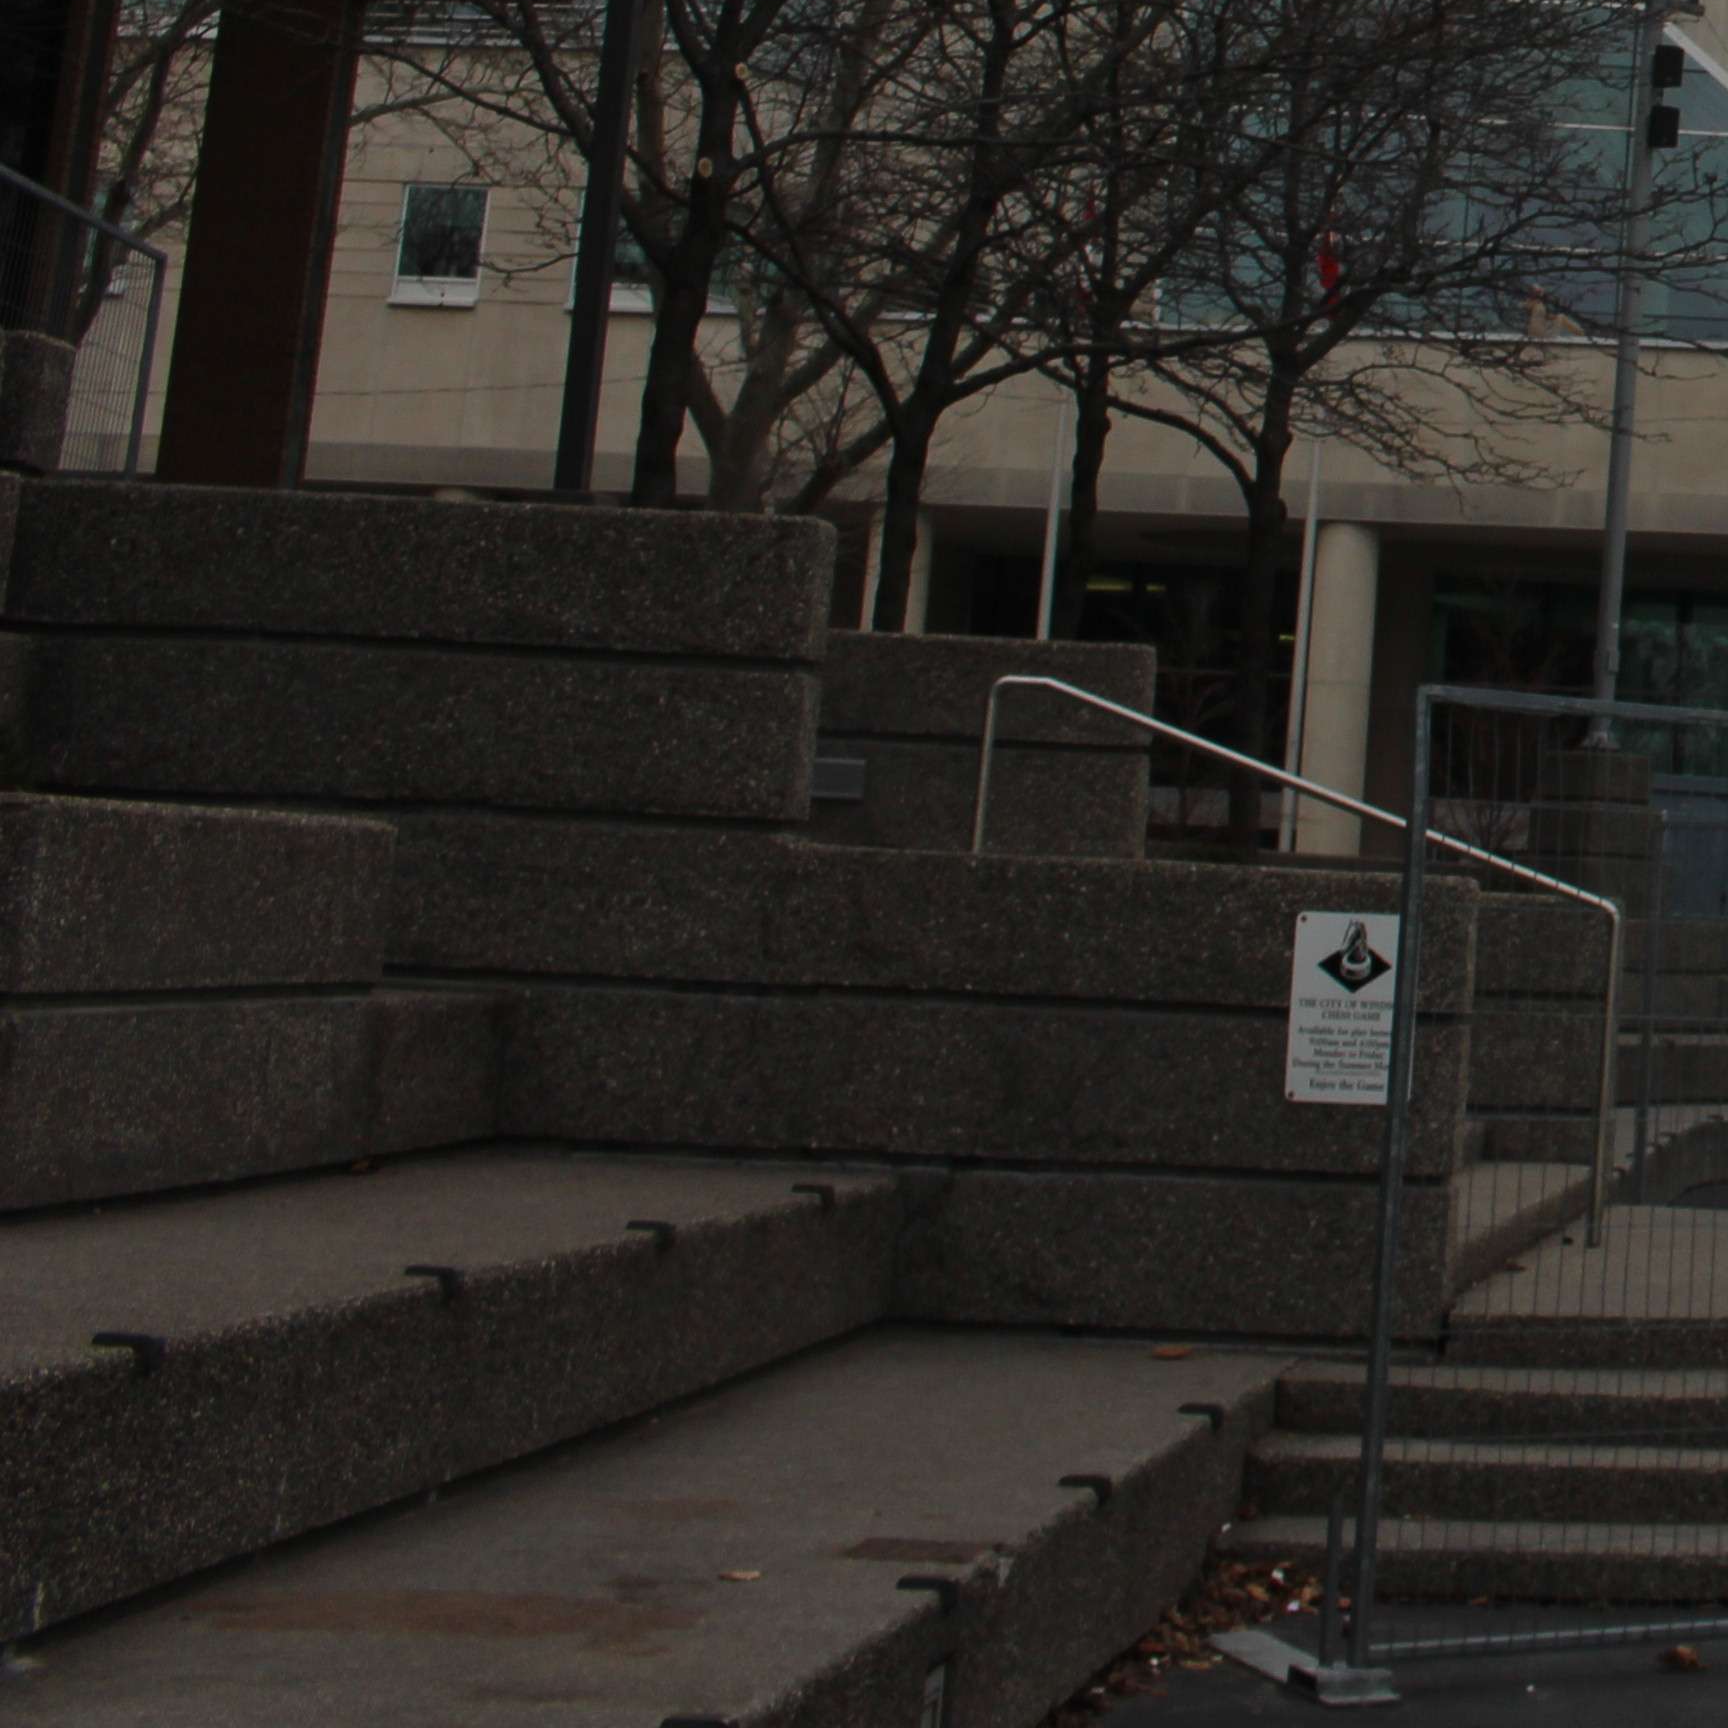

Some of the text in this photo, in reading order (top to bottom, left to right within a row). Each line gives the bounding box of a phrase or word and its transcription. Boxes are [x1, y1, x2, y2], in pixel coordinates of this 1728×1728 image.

[1309, 1078, 1384, 1090] Enjoy the Game
